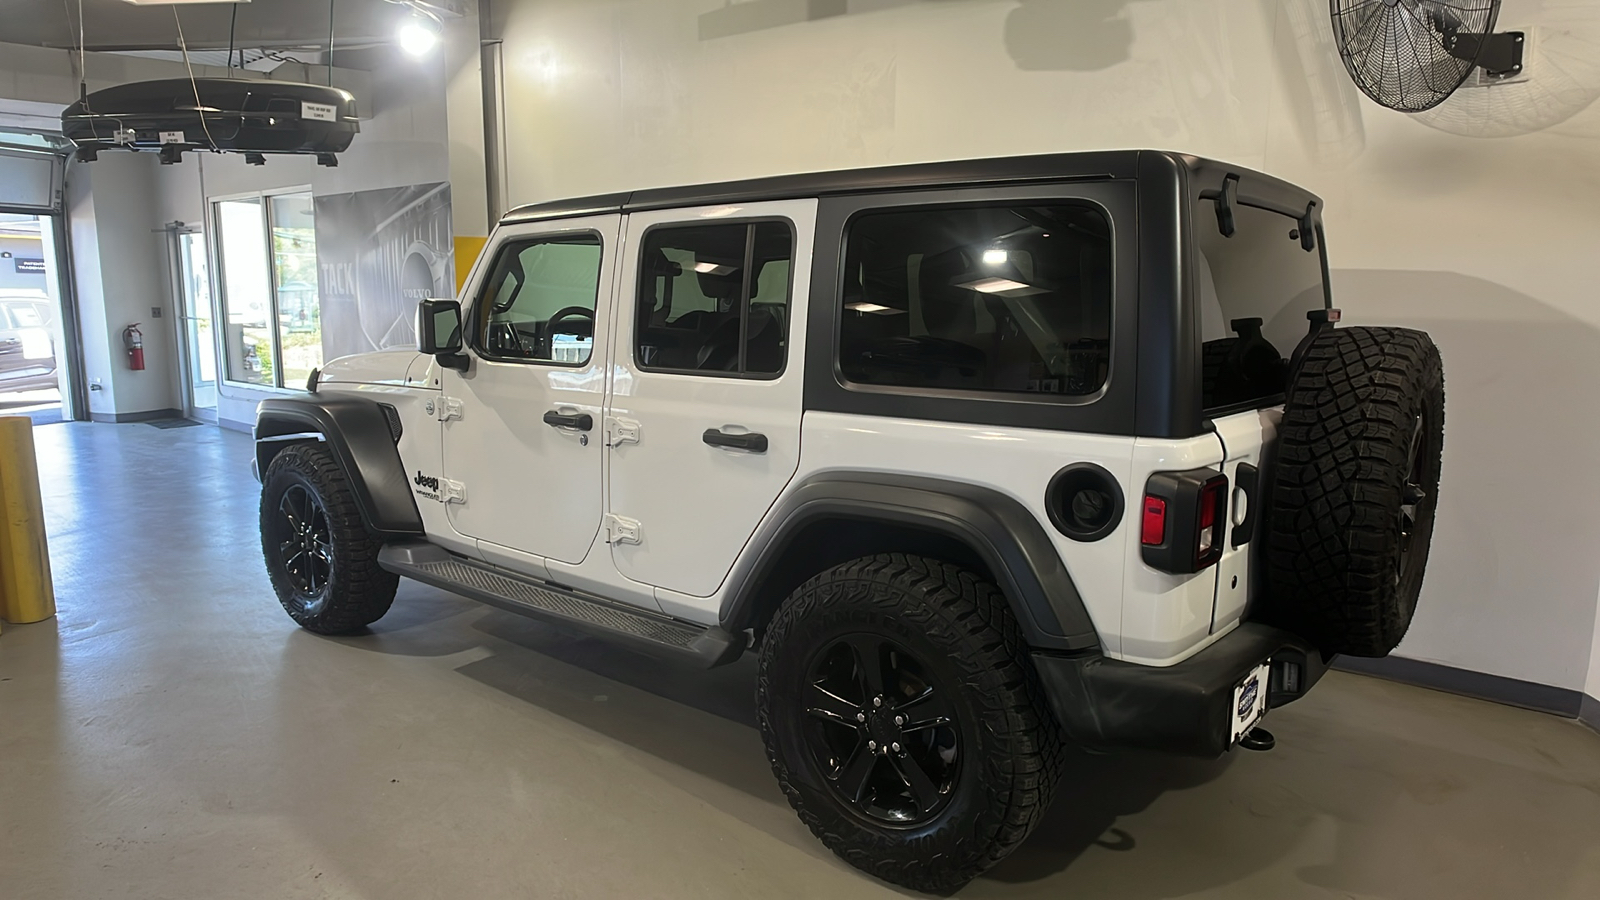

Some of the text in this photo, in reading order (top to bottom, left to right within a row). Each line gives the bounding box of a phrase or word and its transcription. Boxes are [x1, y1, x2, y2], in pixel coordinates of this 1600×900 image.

[321, 263, 355, 295] TACK
[403, 288, 432, 299] VOLVO
[414, 470, 438, 492] Jeep
